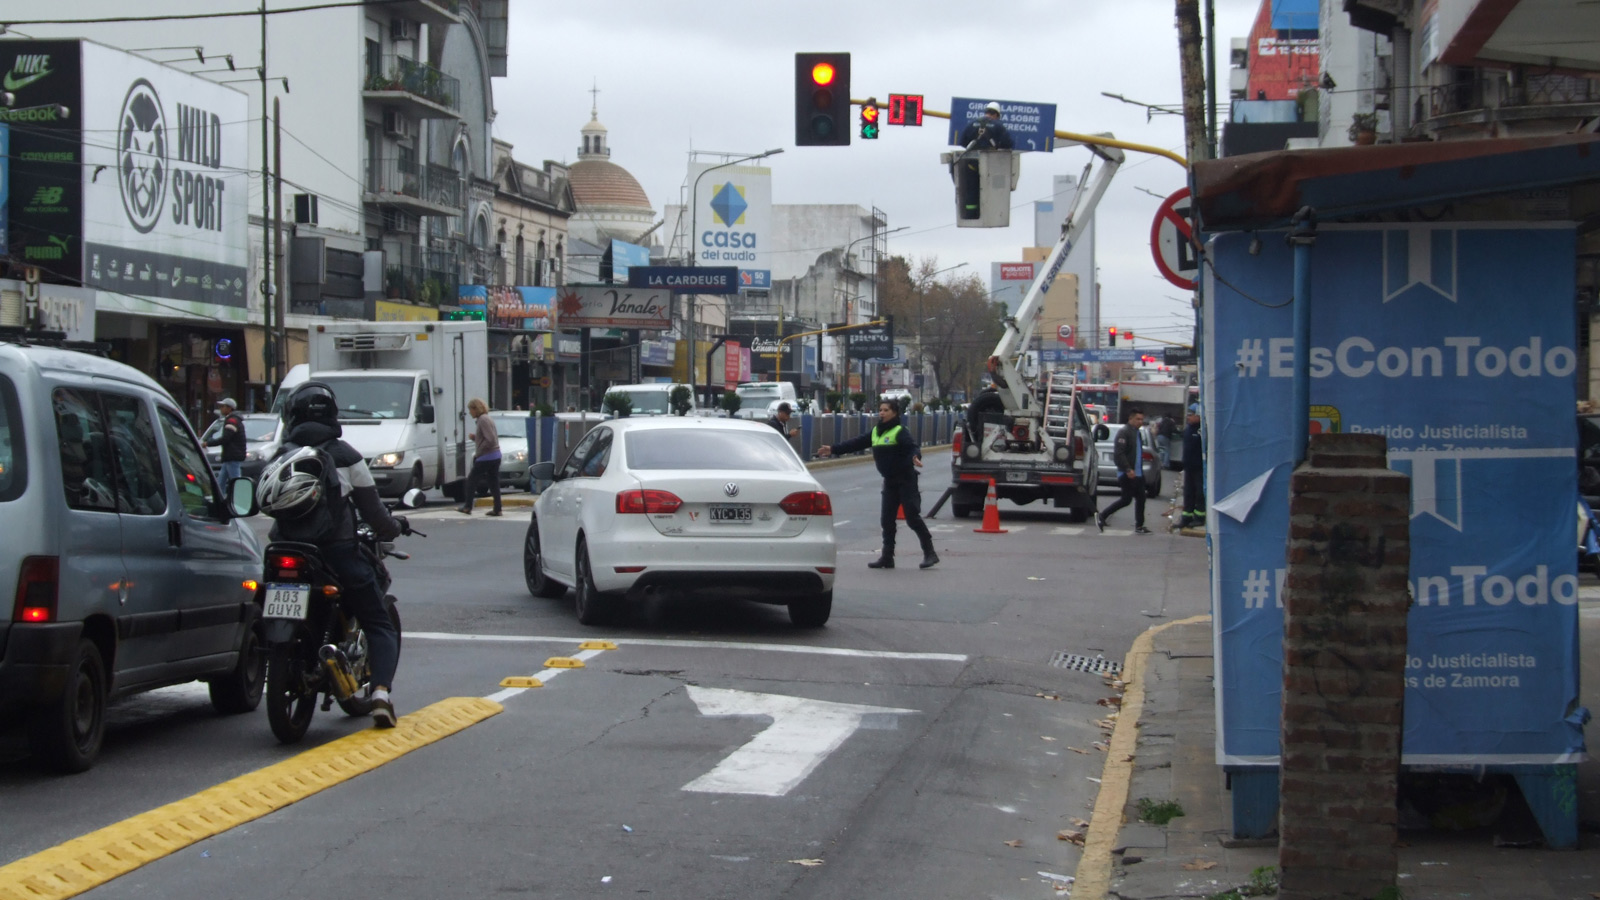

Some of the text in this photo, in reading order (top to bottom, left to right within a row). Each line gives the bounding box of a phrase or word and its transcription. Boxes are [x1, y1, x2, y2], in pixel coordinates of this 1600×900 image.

[14, 54, 50, 73] NIKE
[0, 107, 57, 121] Reebok
[1000, 105, 1039, 114] LAPRIDA
[1010, 114, 1041, 123] SOBRE
[1002, 123, 1038, 132] ERECHA
[176, 102, 221, 170] WILD
[172, 168, 225, 232] SPORT
[702, 230, 756, 249] casa
[25, 246, 62, 259] PUMA
[701, 249, 756, 261] del audio
[648, 275, 727, 285] LA CARDEUSE
[497, 303, 549, 318] REGALERIA
[603, 289, 667, 319] Vanalex
[849, 330, 889, 344] piero
[1237, 336, 1577, 379] #EsConTodo
[1419, 423, 1528, 440] Justicialista
[710, 507, 729, 520] KYC
[734, 508, 751, 520] 135
[1427, 653, 1537, 669] Justicialista
[1423, 674, 1447, 688] de
[1451, 673, 1520, 688] Zamora
